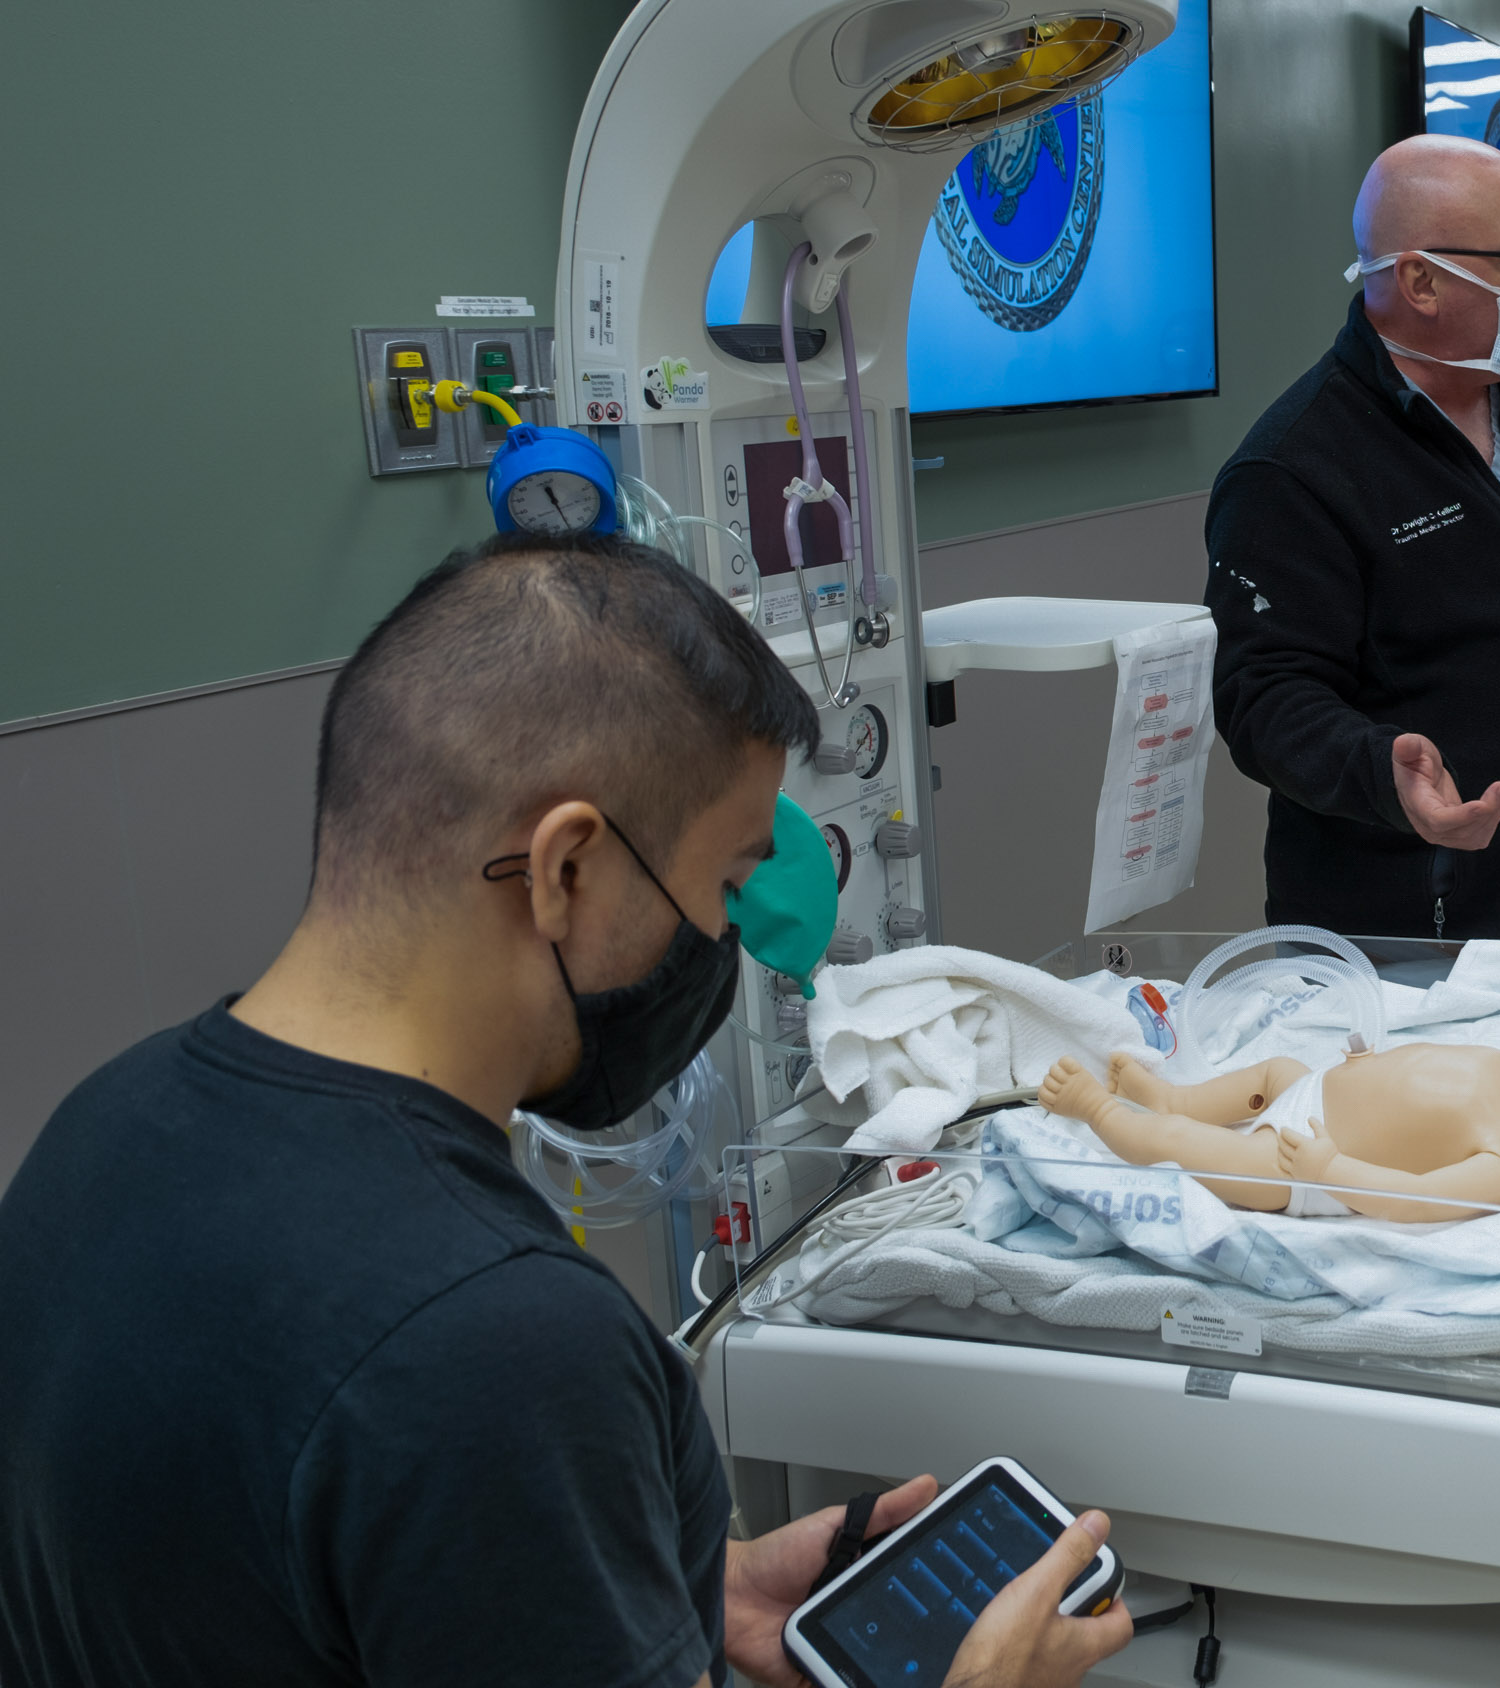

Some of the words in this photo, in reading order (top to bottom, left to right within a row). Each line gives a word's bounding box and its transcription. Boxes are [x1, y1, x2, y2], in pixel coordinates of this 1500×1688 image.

[967, 226, 1077, 304] SIMULATION
[672, 383, 704, 395] Panda
[1402, 516, 1429, 531] Dwight
[1394, 532, 1418, 545] Trauma
